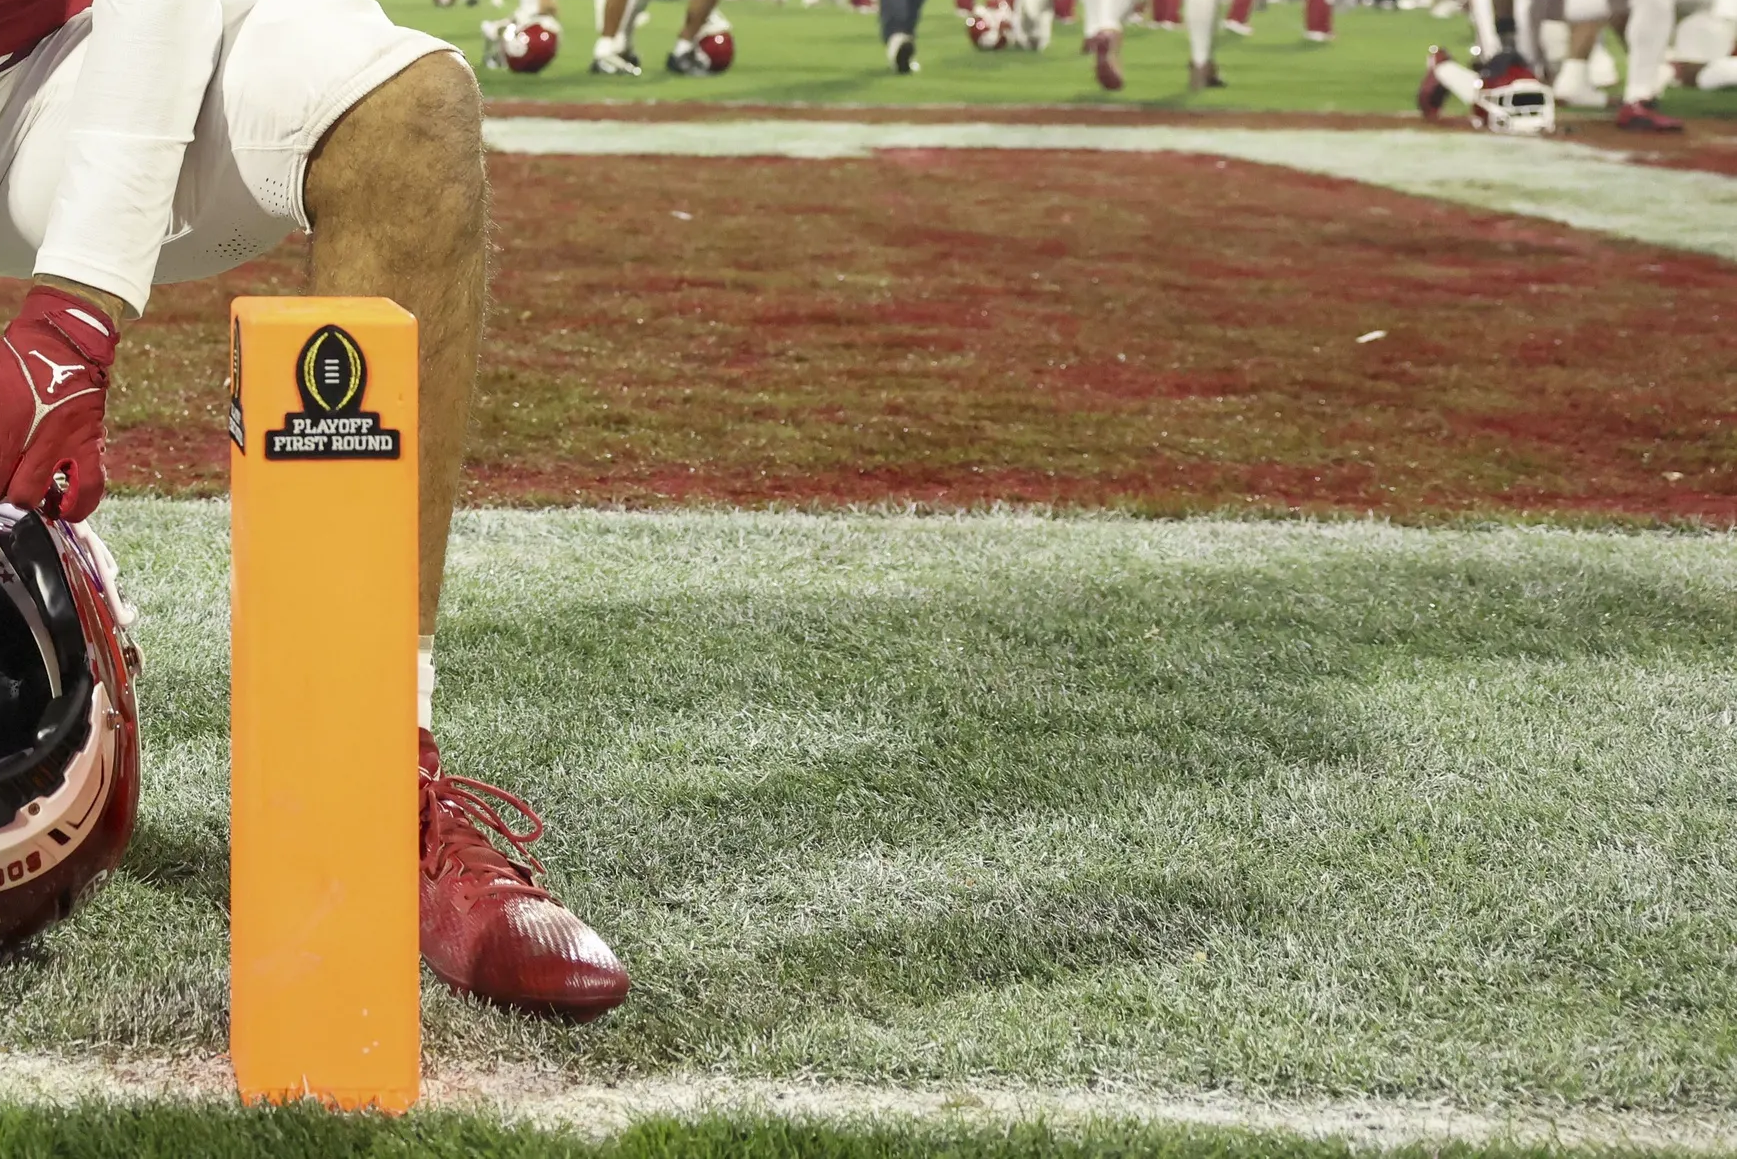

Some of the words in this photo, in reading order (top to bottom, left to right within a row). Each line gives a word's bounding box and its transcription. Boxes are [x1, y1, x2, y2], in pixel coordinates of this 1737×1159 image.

[292, 418, 374, 434] PLAYOFF
[273, 435, 328, 451] FIRST
[331, 435, 393, 451] ROUND
